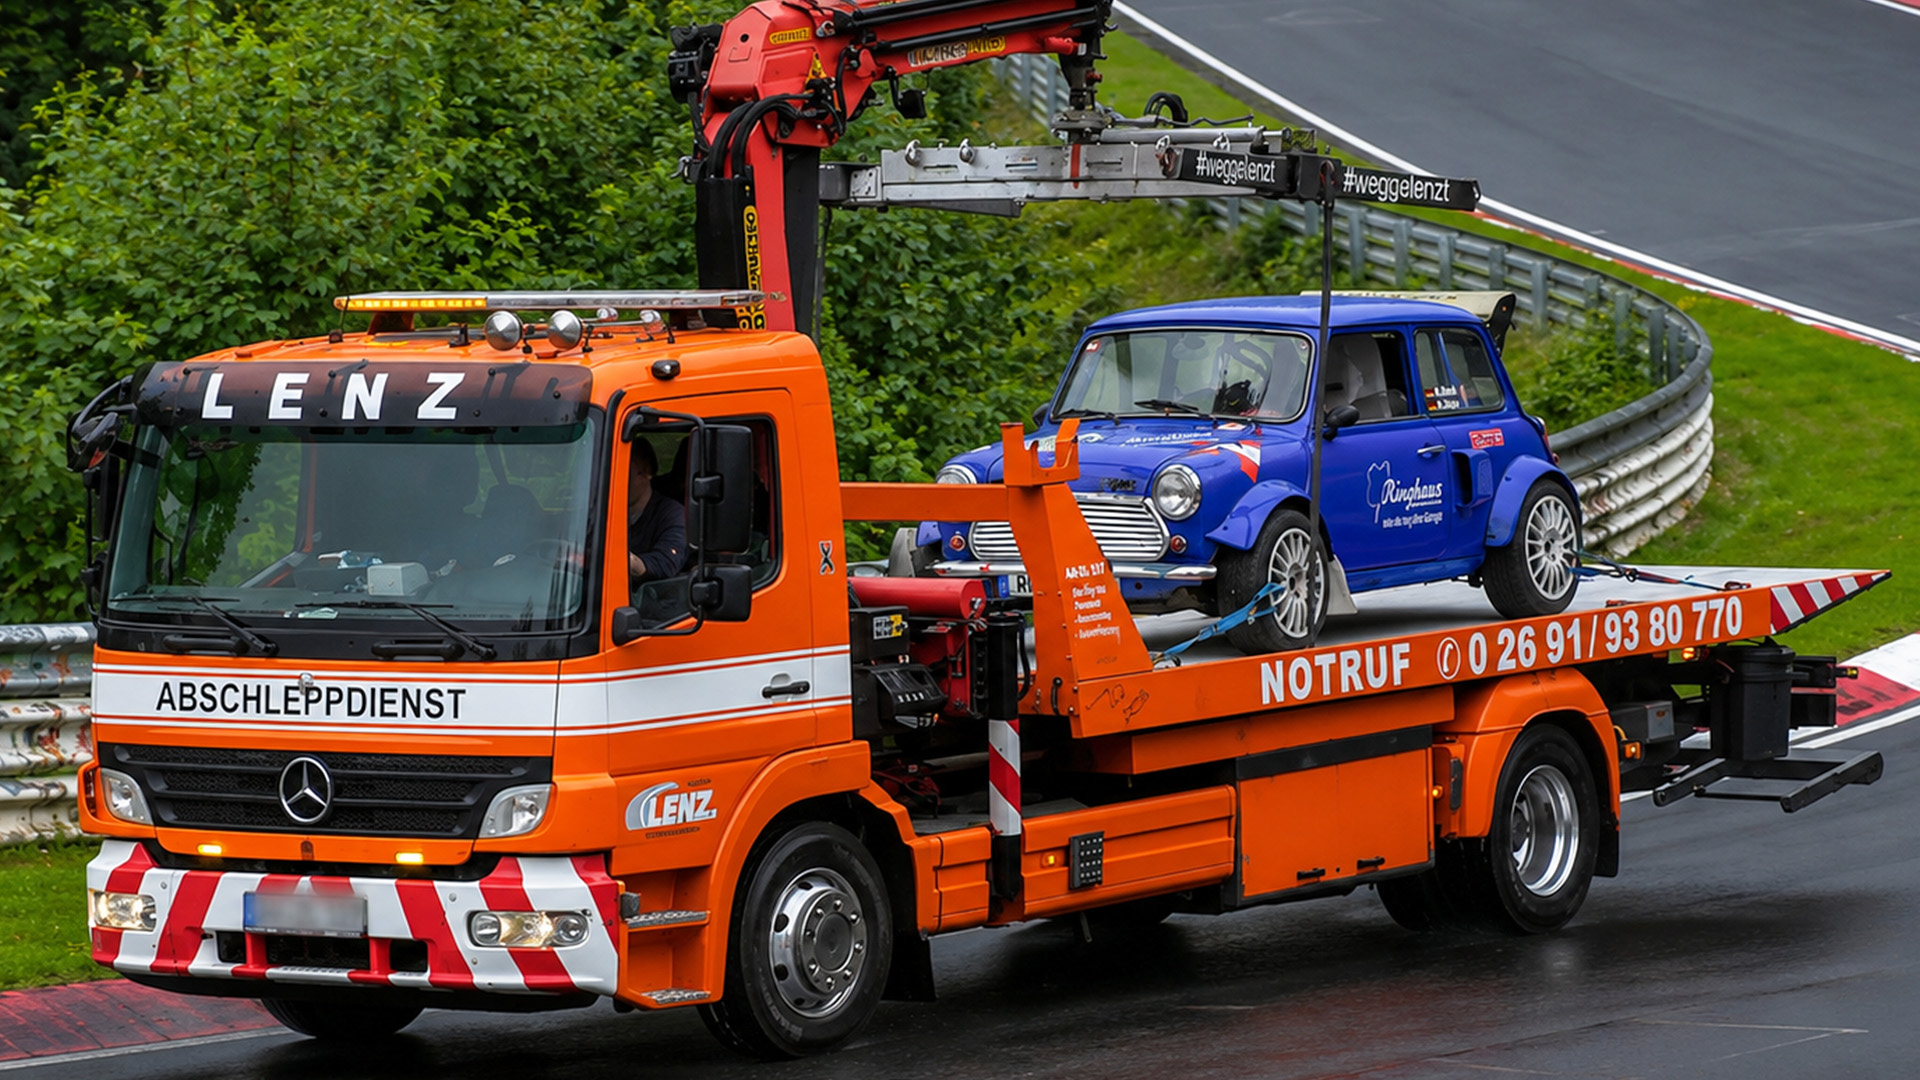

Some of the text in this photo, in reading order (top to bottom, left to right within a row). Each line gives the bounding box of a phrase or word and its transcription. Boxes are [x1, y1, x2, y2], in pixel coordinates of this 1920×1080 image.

[1195, 152, 1276, 186] #weggelenzt
[1342, 167, 1451, 203] #weggelenzt
[201, 372, 465, 421] LENZ
[1381, 477, 1443, 511] Ringhaus
[1260, 642, 1410, 705] NOTRUF
[1468, 631, 1487, 676] 0
[1496, 624, 1537, 672] 26
[1648, 603, 1683, 647] 80
[1691, 595, 1743, 641] 770
[156, 682, 466, 719] ABSCHLEPPDIENST
[647, 789, 717, 827] LENZ
